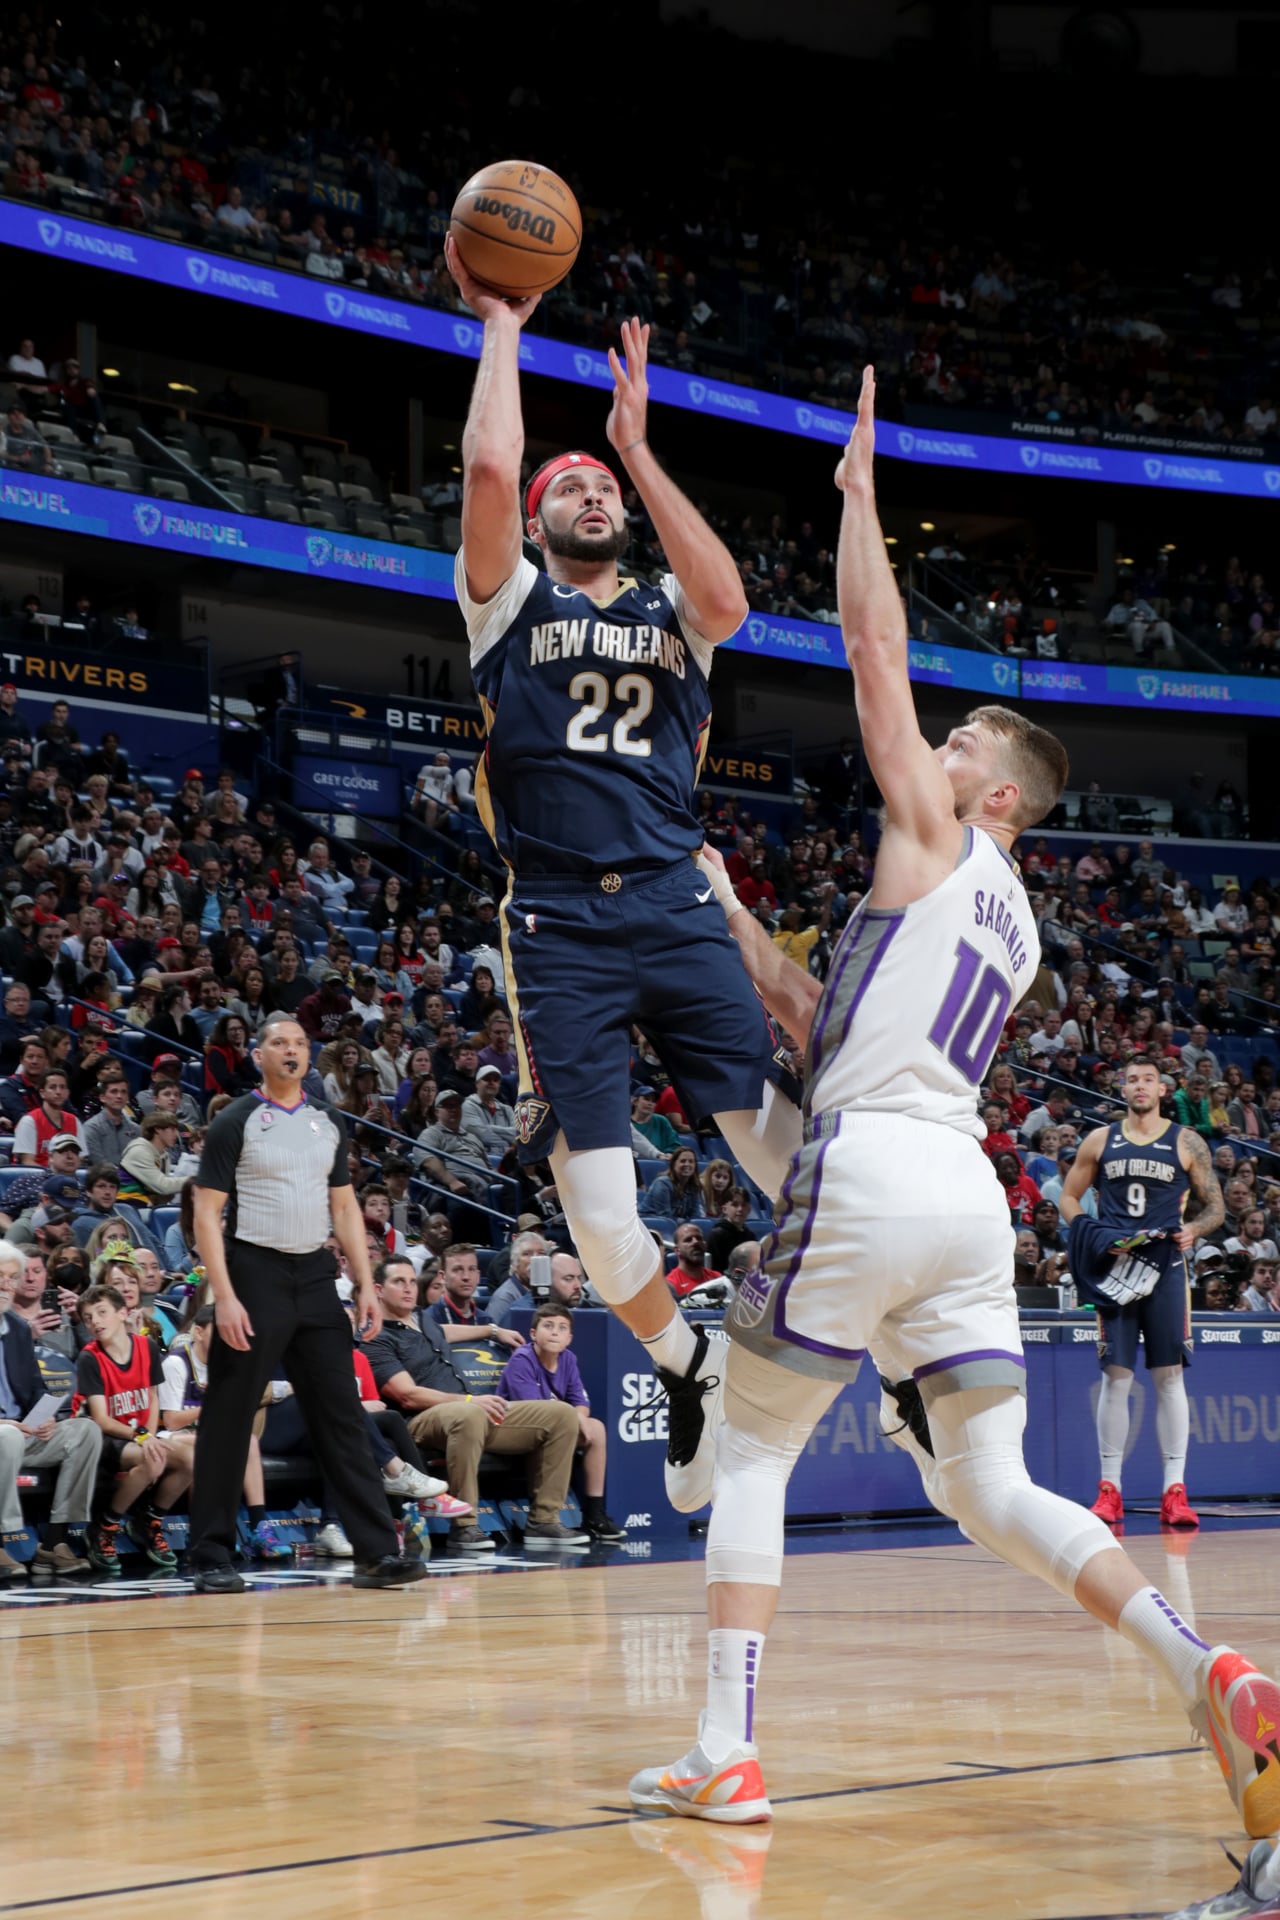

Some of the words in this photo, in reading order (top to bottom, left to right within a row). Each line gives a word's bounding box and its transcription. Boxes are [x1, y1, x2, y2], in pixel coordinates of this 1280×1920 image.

[473, 195, 557, 246] Wilson
[63, 230, 139, 264] FANDUEL
[210, 266, 280, 299] FANDUEL
[0, 484, 71, 515] NDUEL
[162, 514, 248, 548] FANDUEL
[530, 618, 590, 667] NEW
[593, 621, 686, 680] ORLEANS
[768, 627, 833, 653] FANDUEL
[0, 652, 148, 692] TRIVERS
[403, 654, 451, 698] 114
[908, 653, 954, 673] NDUEL
[386, 708, 482, 739] BETRIV
[566, 671, 654, 757] 22
[313, 772, 341, 786] GREY
[342, 776, 380, 791] GOOSE
[974, 889, 1027, 974] SABONIS
[927, 936, 1012, 1087] 10
[1104, 1159, 1127, 1180] NEW
[1128, 1159, 1175, 1183] ORLEANS
[1127, 1183, 1146, 1217] 9
[740, 1282, 766, 1313] SAC
[1201, 1329, 1241, 1344] SEATGEEK
[109, 1387, 149, 1418] PELICAN
[618, 1408, 669, 1443] GEE
[624, 1513, 652, 1528] ANC
